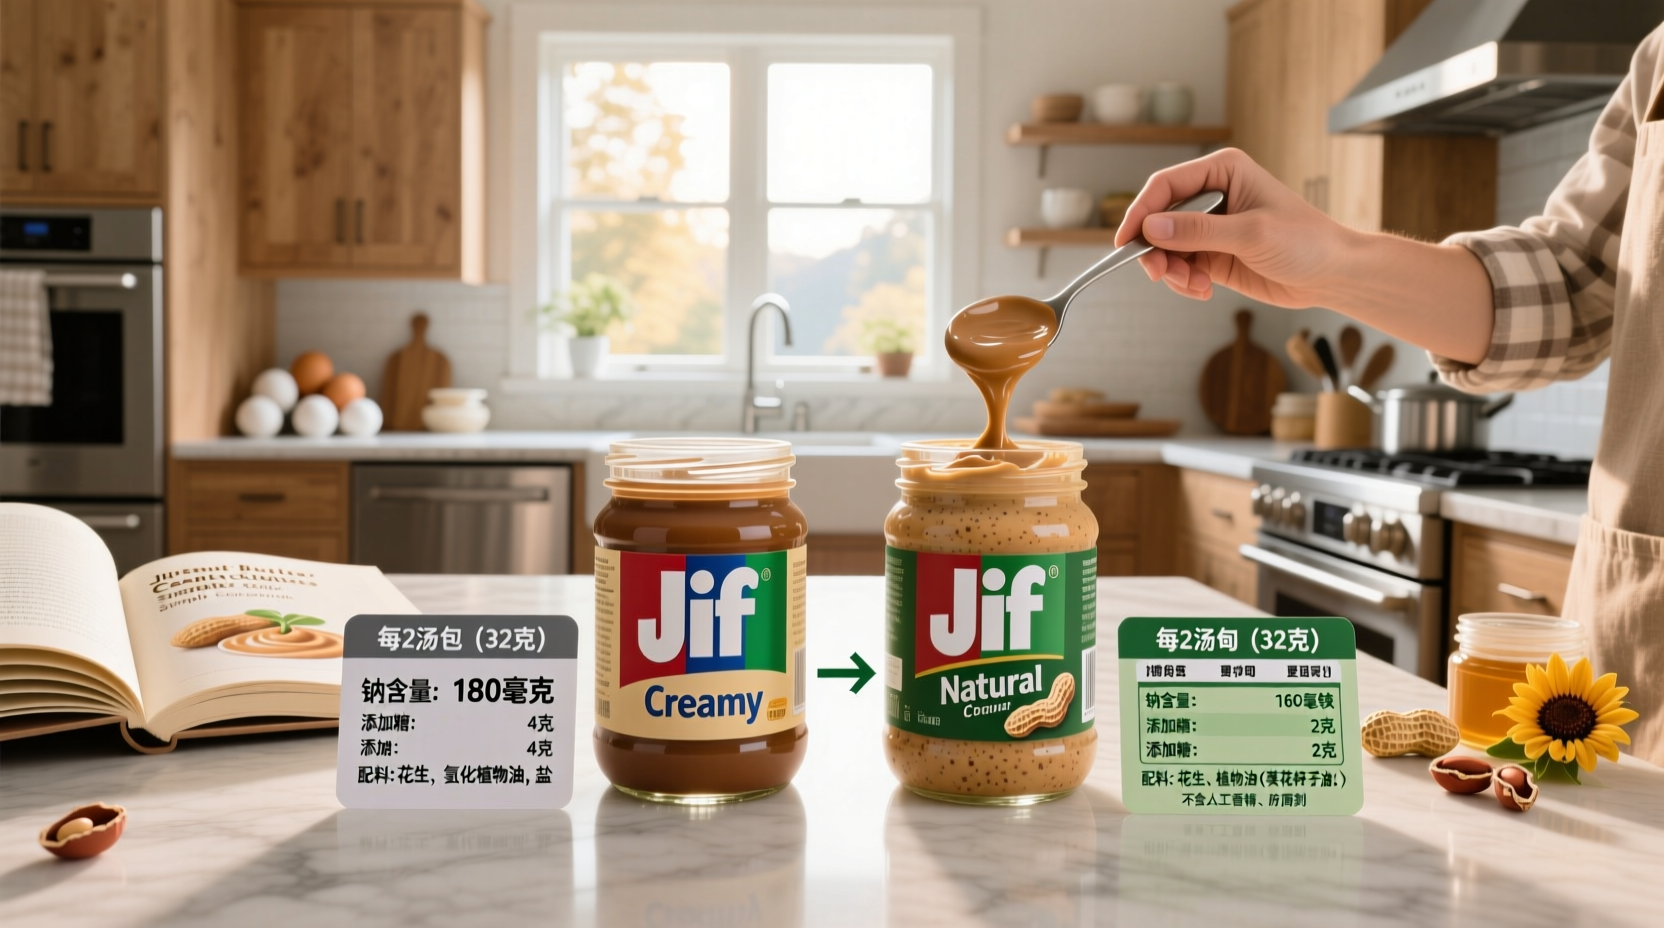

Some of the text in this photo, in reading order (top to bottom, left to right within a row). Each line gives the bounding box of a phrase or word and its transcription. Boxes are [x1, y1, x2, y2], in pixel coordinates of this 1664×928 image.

[638, 566, 759, 663] Jif
[930, 564, 1046, 656] Jif
[453, 676, 555, 704] 180毫克
[940, 664, 1042, 705] Natural
[644, 685, 763, 725] Creamy
[527, 713, 554, 732] 4克
[1310, 717, 1336, 734] 2克
[526, 739, 553, 757] 4克
[1311, 741, 1337, 758] 2克
